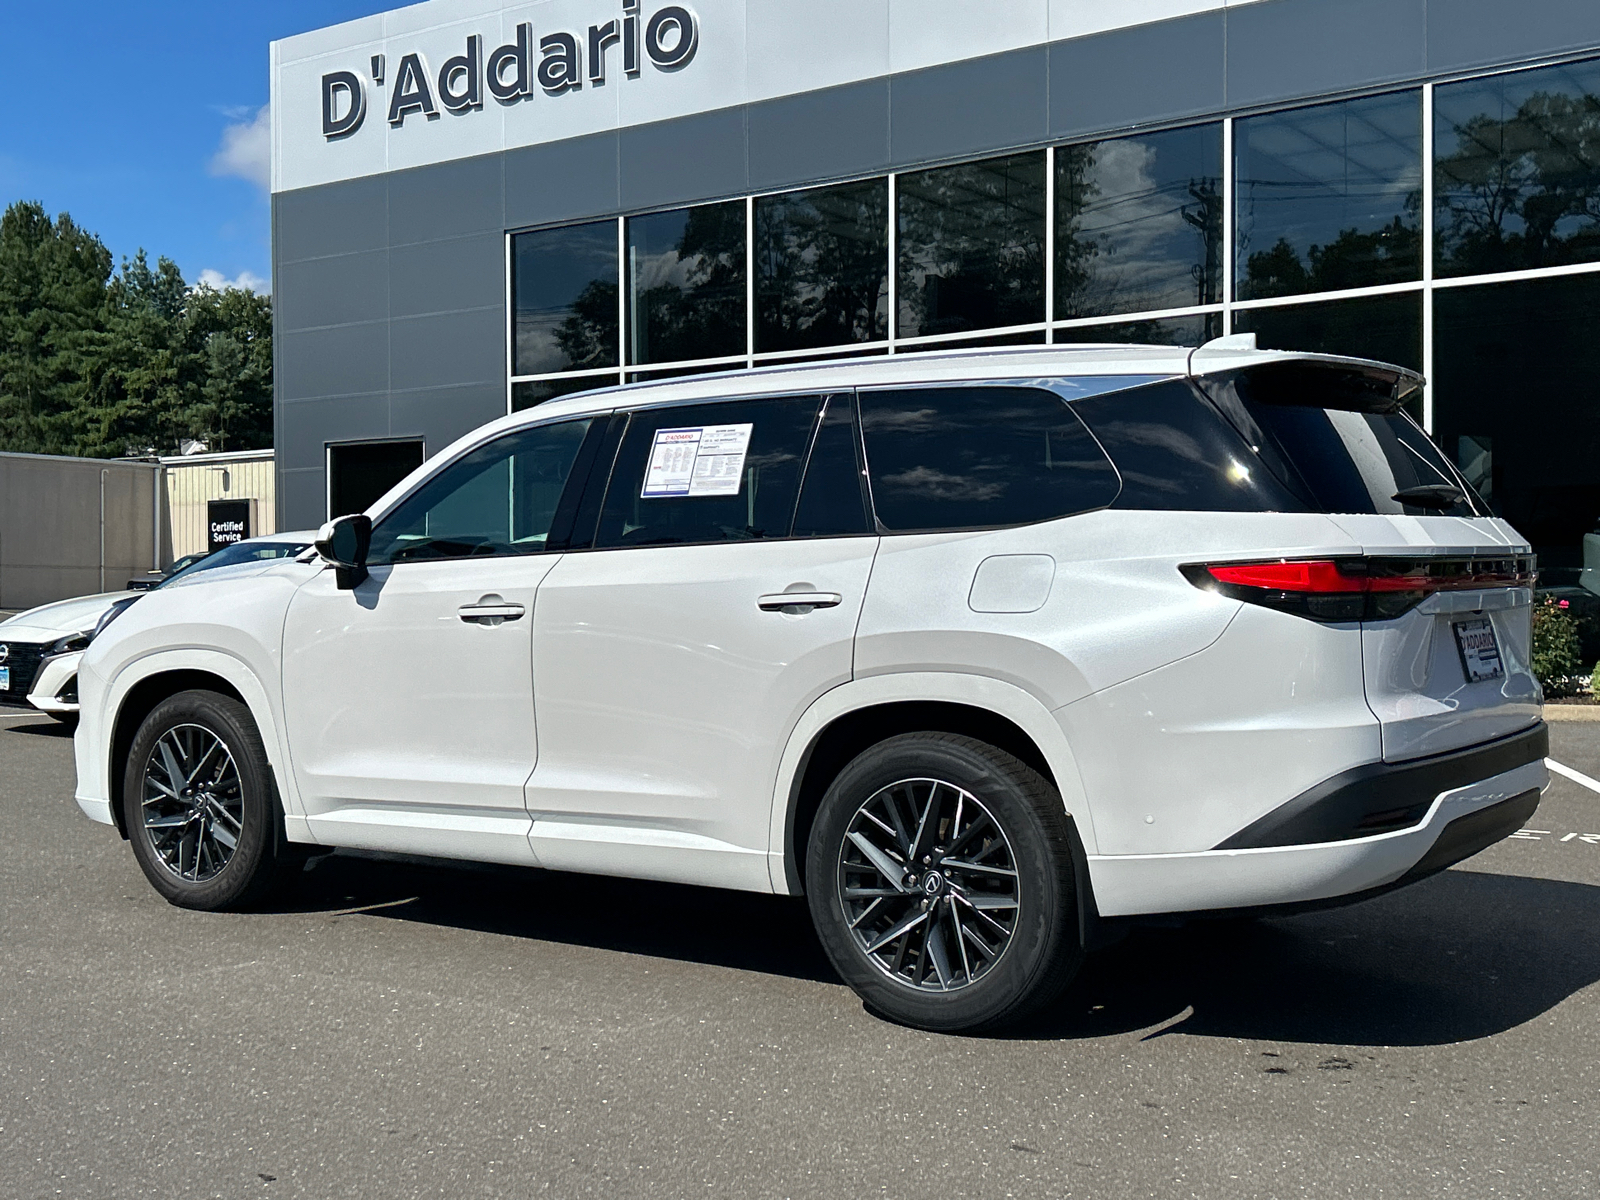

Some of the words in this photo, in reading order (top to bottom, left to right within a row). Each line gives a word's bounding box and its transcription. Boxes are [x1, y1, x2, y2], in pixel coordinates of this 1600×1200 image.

[321, 0, 700, 139] D'Addario
[211, 521, 244, 532] Certified
[213, 532, 242, 543] Service
